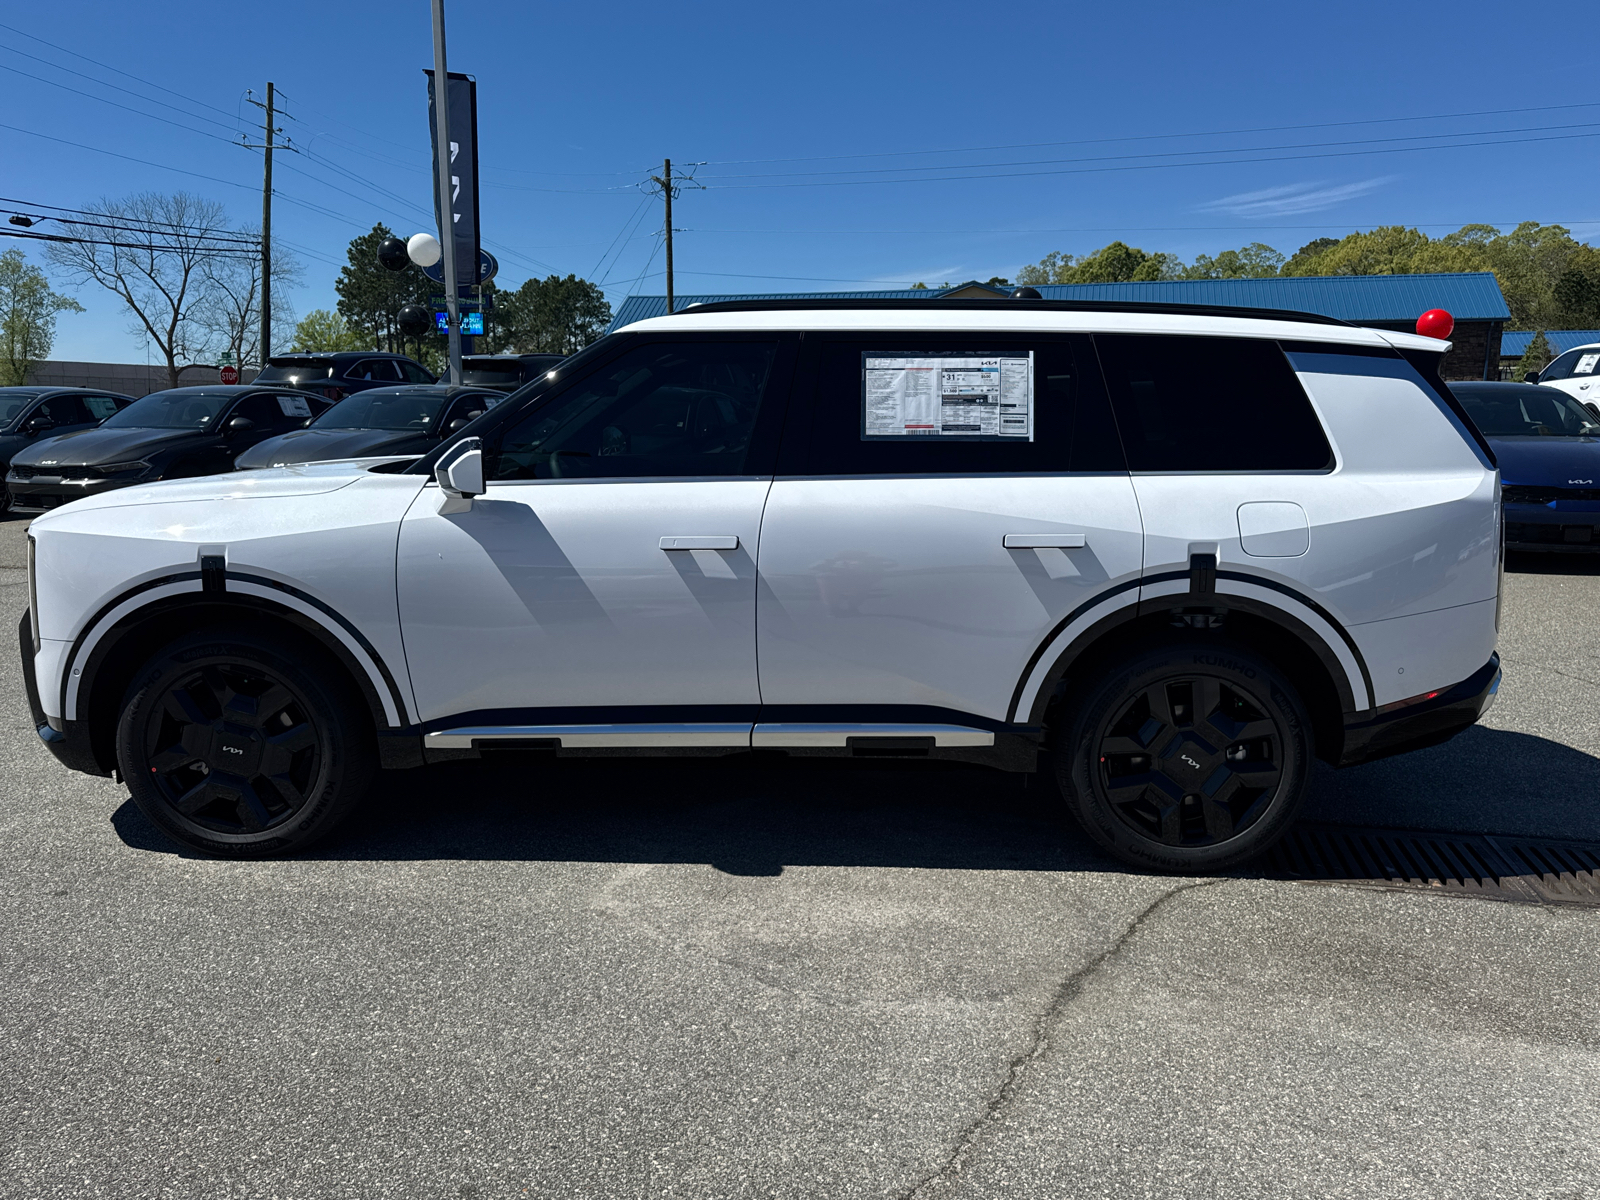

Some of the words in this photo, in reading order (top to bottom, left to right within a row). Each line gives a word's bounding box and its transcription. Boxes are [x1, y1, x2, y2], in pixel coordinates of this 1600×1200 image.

[221, 372, 237, 380] STOP
[1193, 654, 1257, 680] KUMHO
[222, 745, 243, 755] KIA
[1180, 754, 1200, 770] KIA
[298, 780, 337, 832] KUMHO
[1129, 843, 1192, 868] KUMHO
